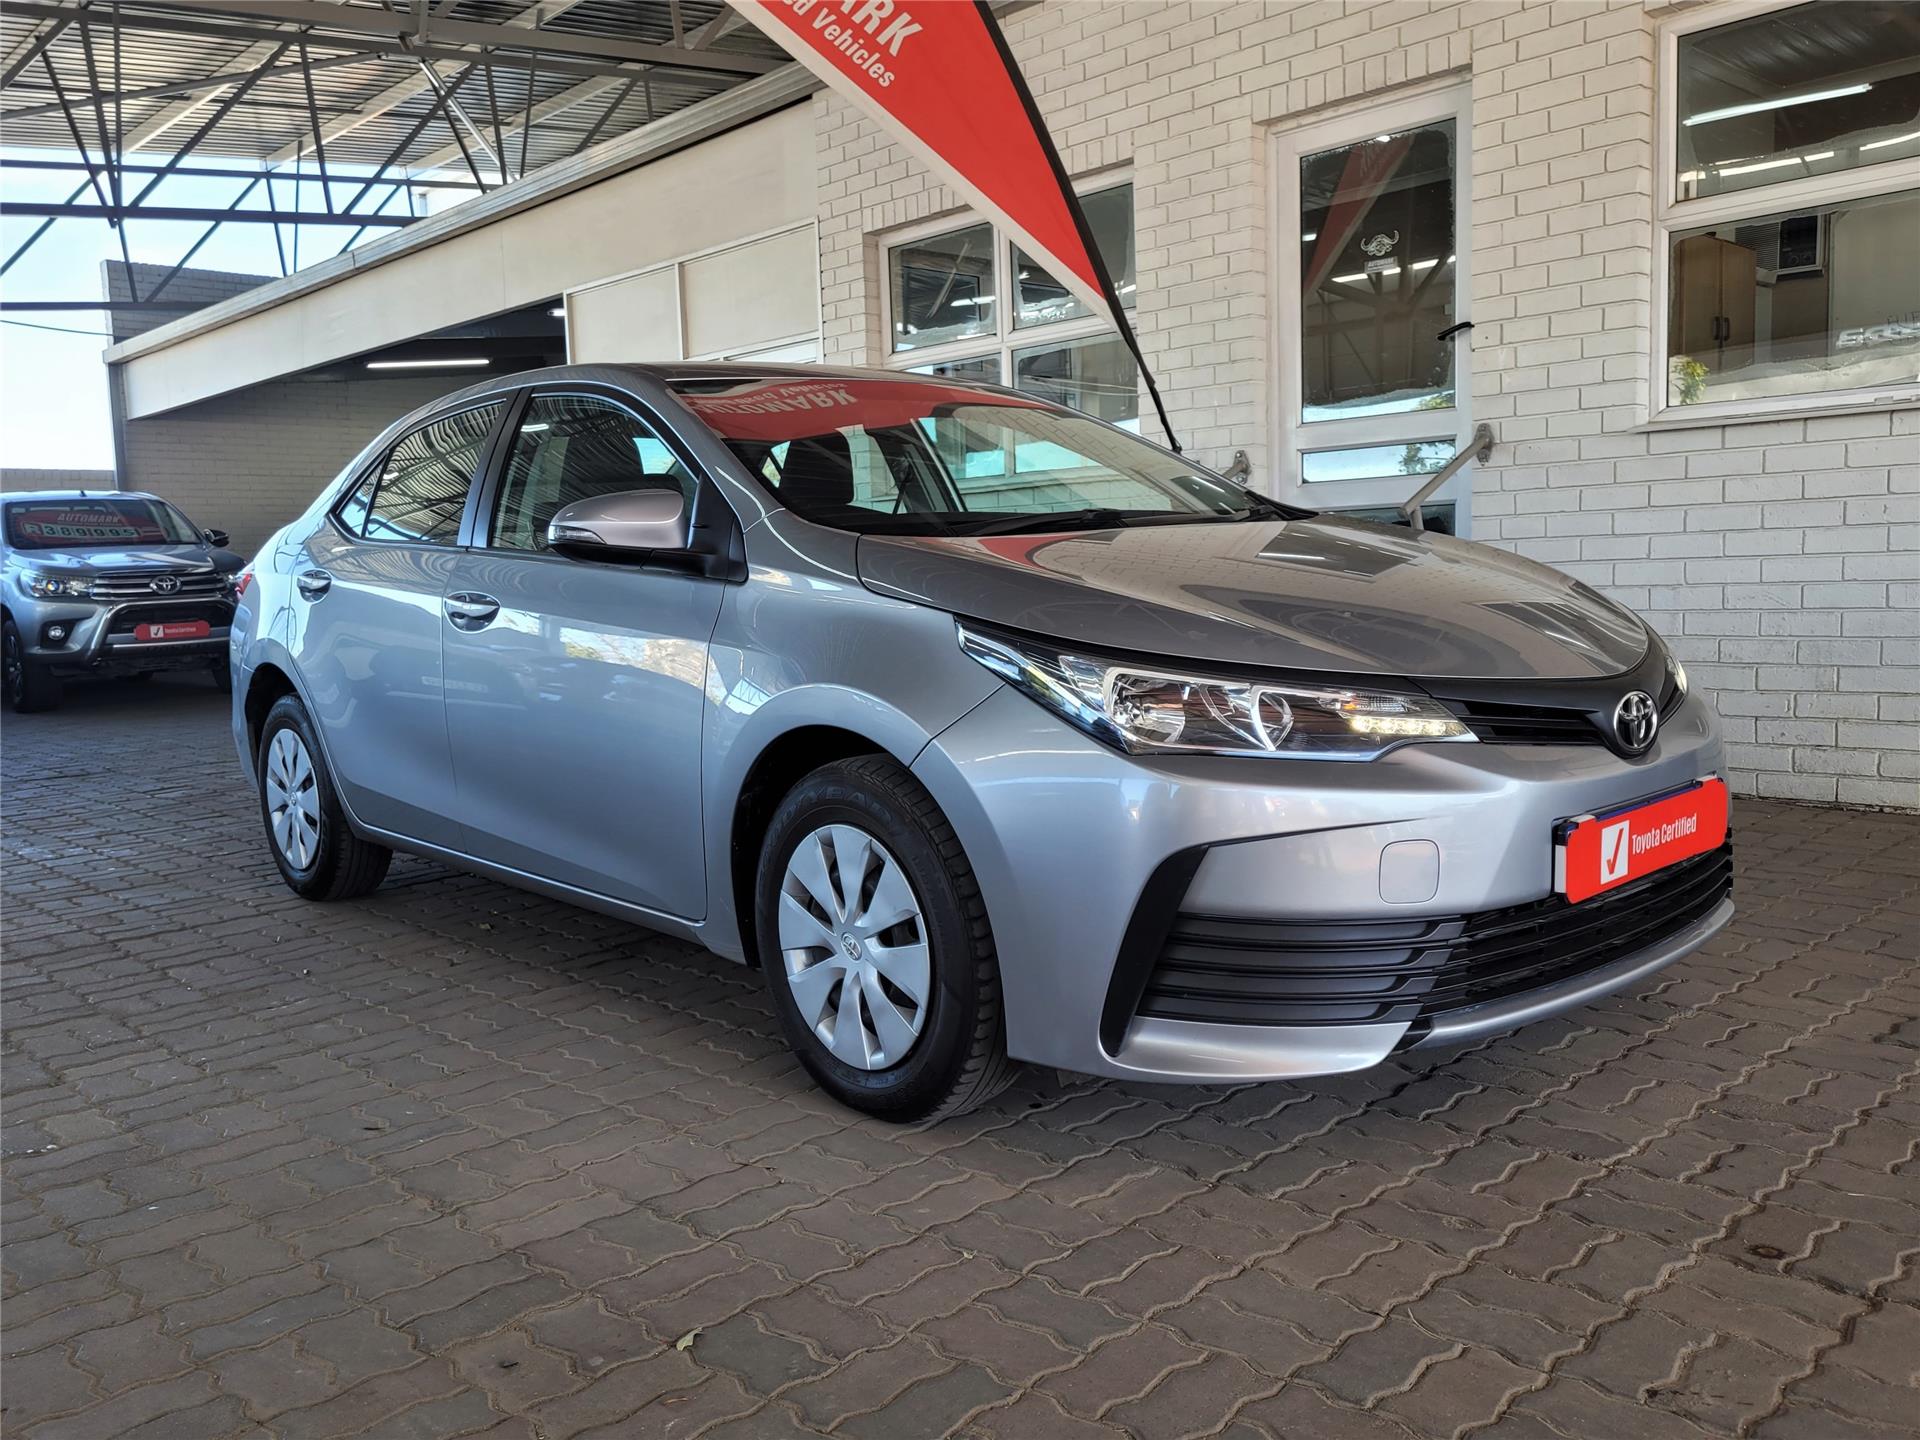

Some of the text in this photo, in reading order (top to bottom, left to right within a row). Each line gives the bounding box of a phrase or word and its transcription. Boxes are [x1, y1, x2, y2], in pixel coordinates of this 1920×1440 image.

[782, 0, 895, 87] d Vehicles
[840, 0, 922, 57] RK
[57, 513, 120, 524] AUTOMARK
[1632, 812, 1697, 855] Toyota Certified
